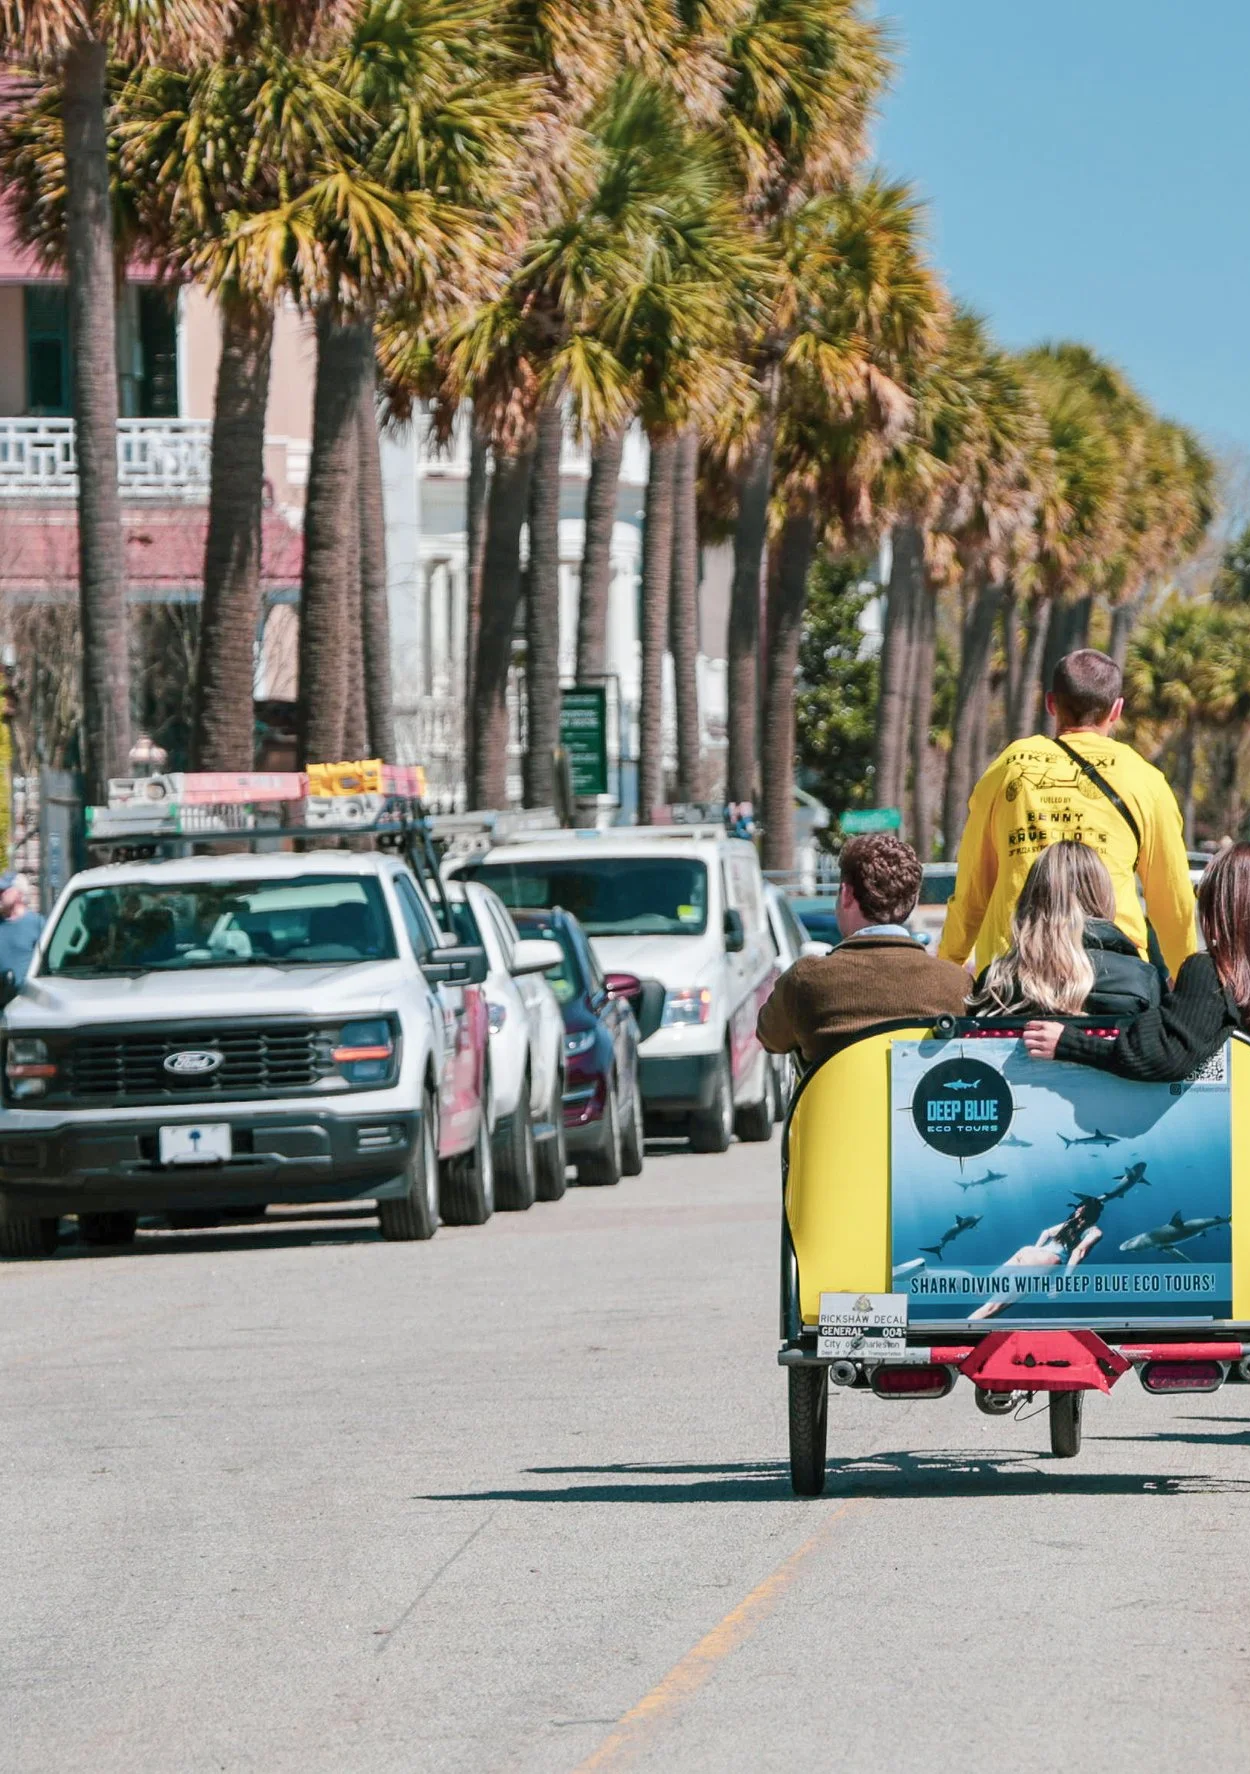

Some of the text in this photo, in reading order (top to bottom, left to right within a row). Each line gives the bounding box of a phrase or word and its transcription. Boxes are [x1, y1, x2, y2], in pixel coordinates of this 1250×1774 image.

[1027, 811, 1084, 822] BENNY
[171, 1052, 213, 1070] Ford
[927, 1099, 999, 1121] DEEP BLUE
[911, 1274, 1216, 1294] SHARK DIVING WITH DEEP BLUE ECO TOURS!
[820, 1314, 905, 1324] RICKSHAW DECAL
[821, 1326, 864, 1336] GENERAL
[824, 1340, 841, 1350] City
